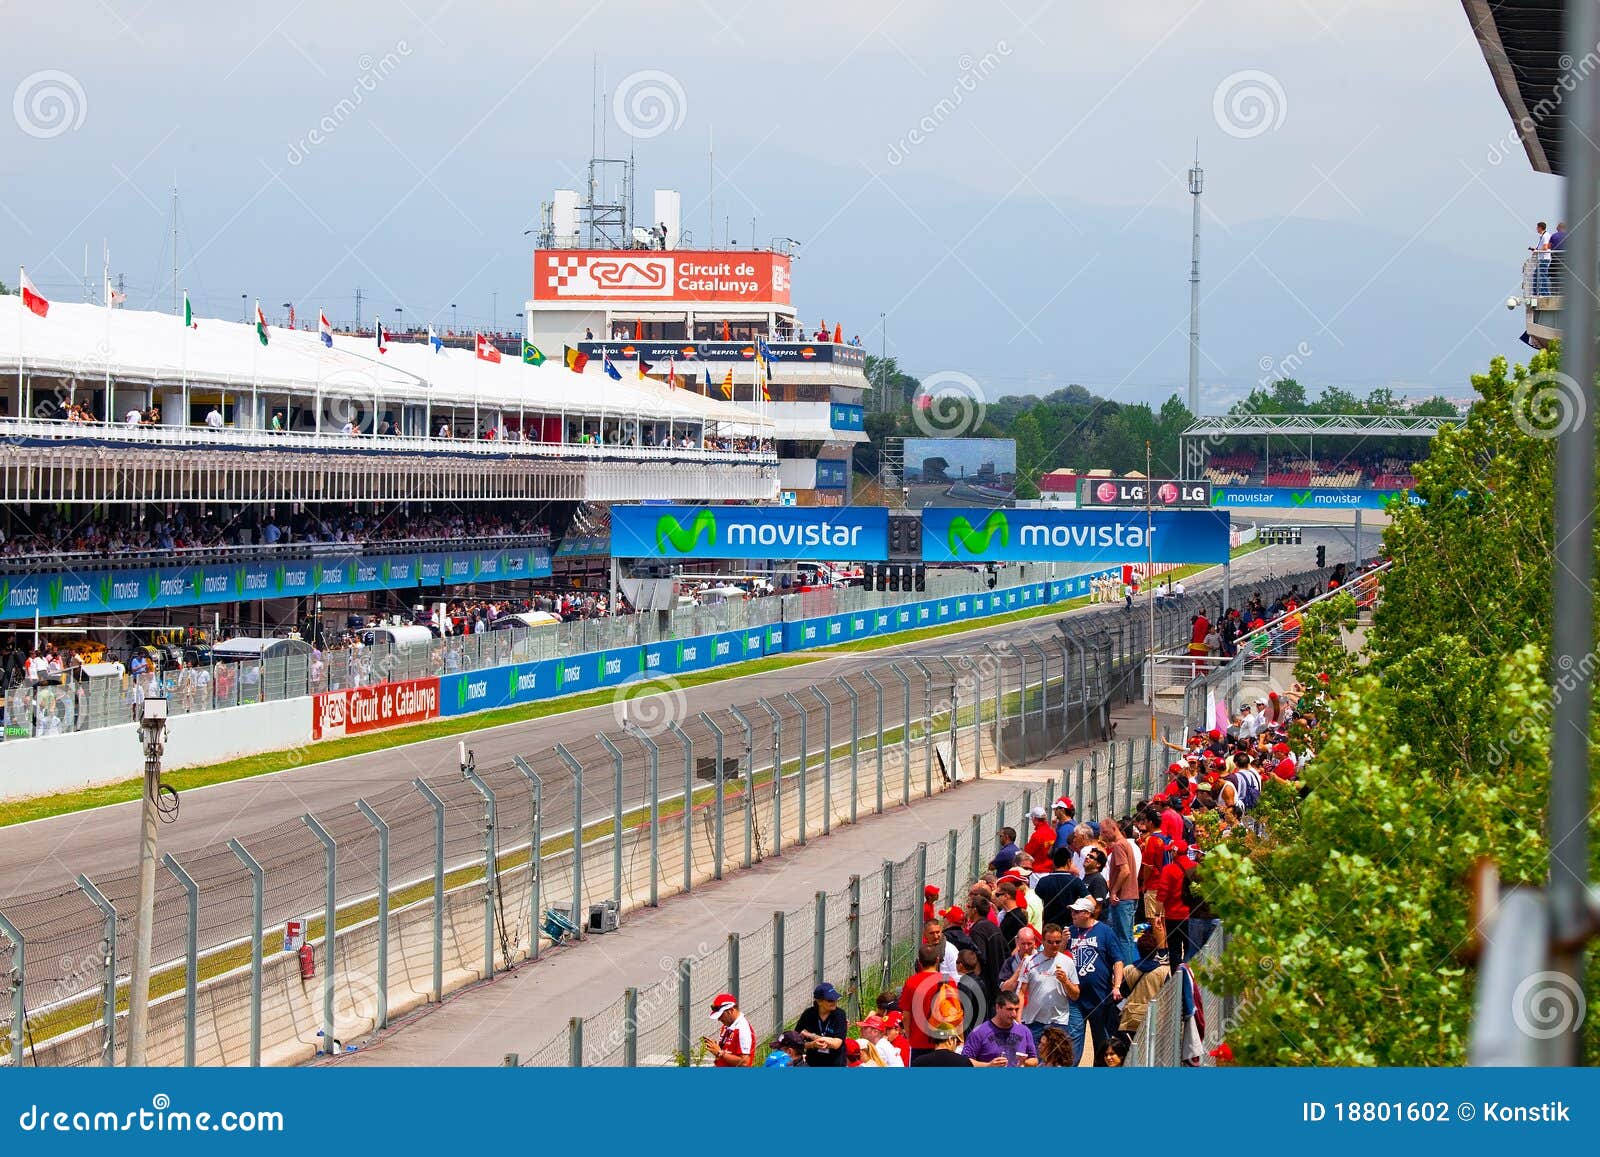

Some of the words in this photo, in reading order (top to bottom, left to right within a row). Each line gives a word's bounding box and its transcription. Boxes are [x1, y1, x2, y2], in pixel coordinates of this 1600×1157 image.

[678, 262, 731, 276] Circuit
[735, 262, 755, 276] de
[678, 278, 759, 294] Catalunya
[1121, 486, 1143, 500] LG
[1182, 487, 1205, 500] LG
[1227, 493, 1274, 502] movistar
[1314, 494, 1362, 504] movistar
[727, 521, 863, 546] movistar
[1020, 522, 1156, 547] movistar
[160, 577, 184, 596] movistar
[204, 574, 228, 592] movistar
[246, 571, 268, 589] movistar
[285, 569, 307, 586] movistar
[10, 585, 39, 606] movistar
[62, 582, 91, 602] movistar
[113, 579, 140, 600] movistar
[518, 672, 536, 690] movistar
[564, 665, 580, 682] movistar
[467, 680, 487, 700] movistar
[350, 689, 378, 724] Circuit
[381, 686, 393, 719] de
[395, 682, 436, 720] Catalunya
